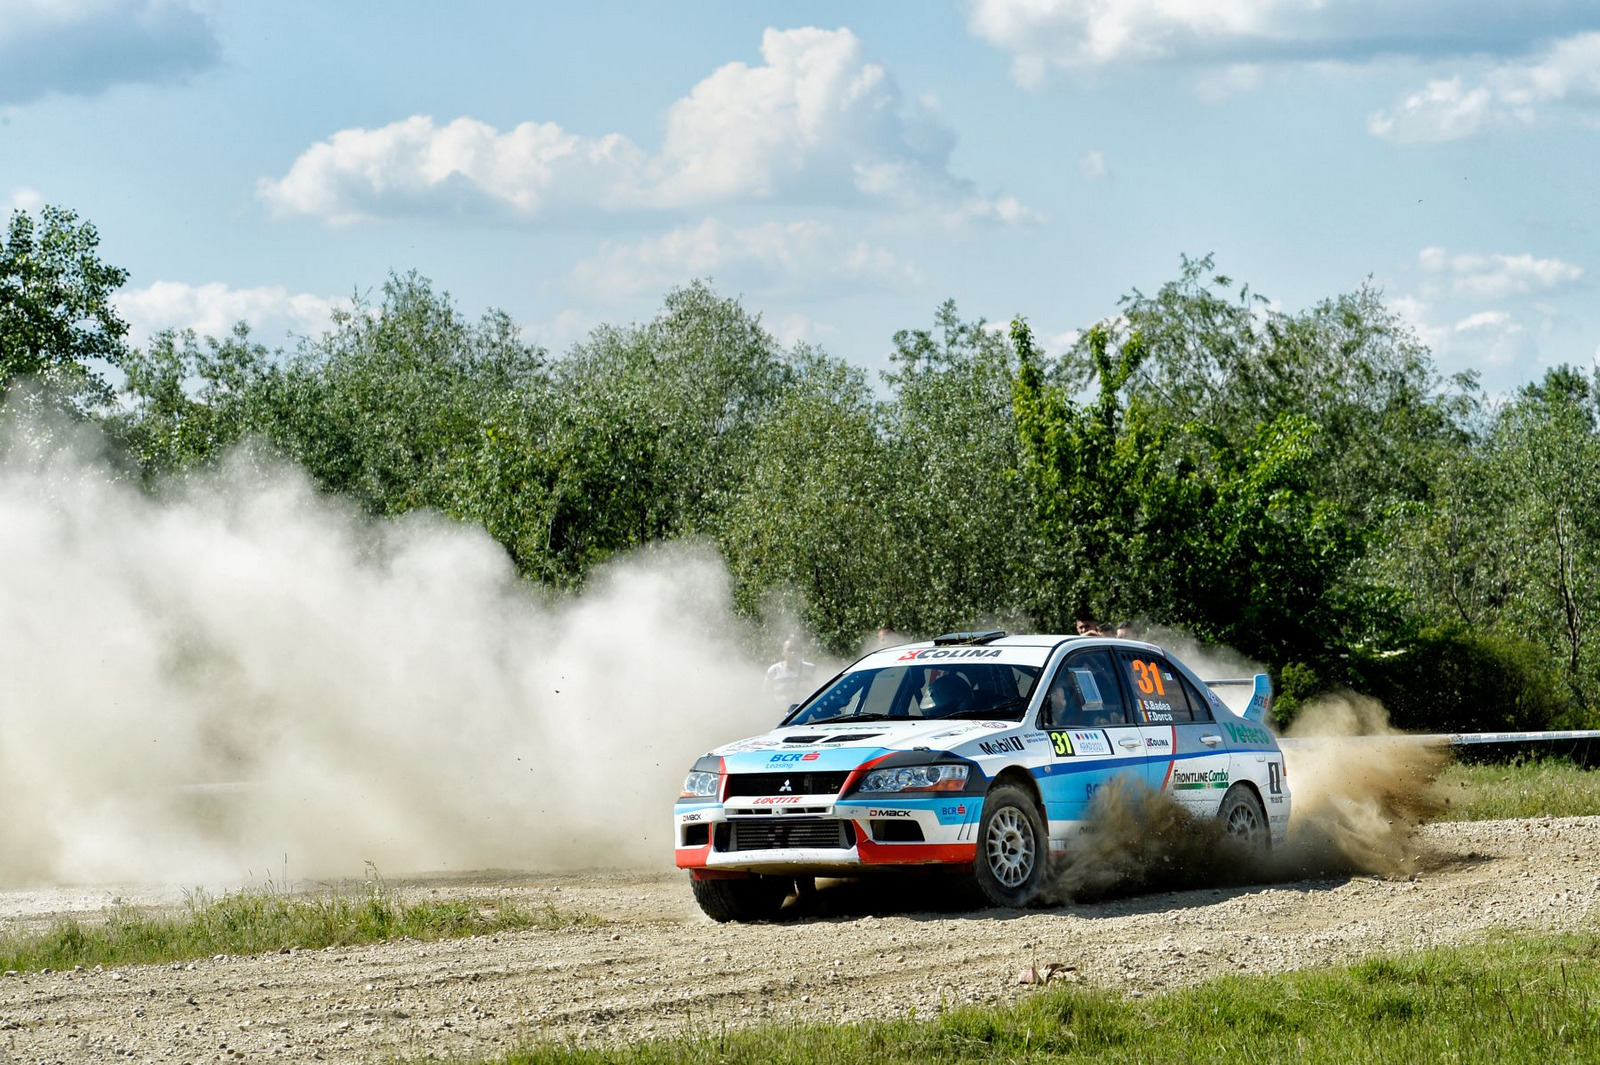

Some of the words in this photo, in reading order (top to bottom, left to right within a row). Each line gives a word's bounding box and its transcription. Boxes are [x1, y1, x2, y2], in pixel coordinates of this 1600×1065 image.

[916, 649, 1003, 659] COLINA
[1132, 659, 1165, 696] 31
[1143, 700, 1171, 711] S.Badea
[979, 738, 1014, 755] Mobil
[1051, 732, 1072, 755] 31
[770, 753, 802, 762] BCR
[1174, 770, 1208, 783] FRONTLINE
[1208, 768, 1229, 782] Combo
[753, 796, 803, 805] LOCTITE
[942, 806, 957, 815] BCR
